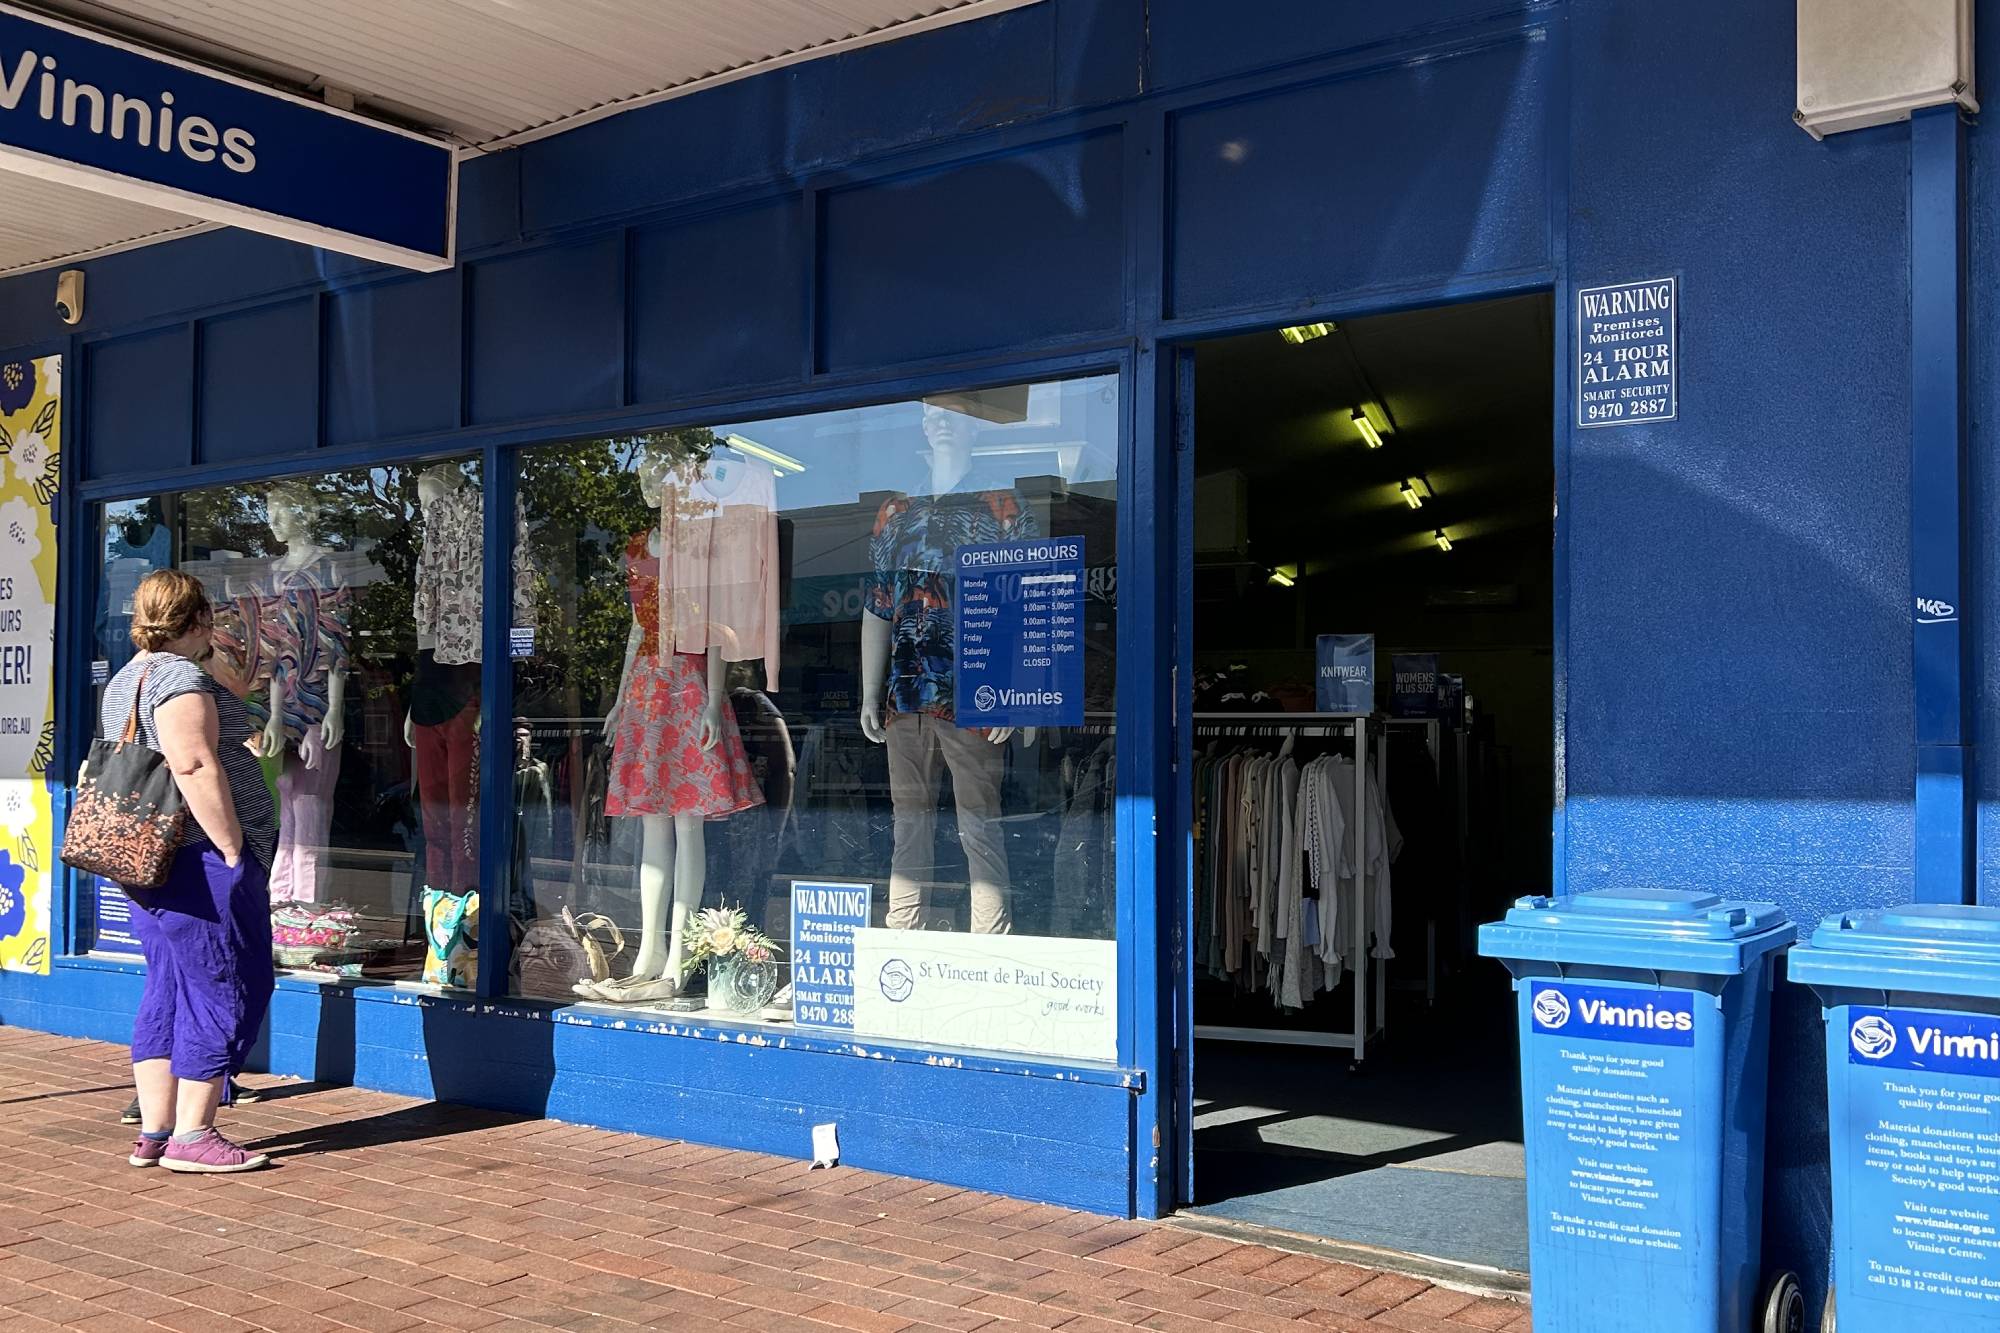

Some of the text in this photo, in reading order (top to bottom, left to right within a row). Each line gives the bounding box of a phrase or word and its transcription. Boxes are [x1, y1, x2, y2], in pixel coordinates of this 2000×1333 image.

[0, 50, 257, 173] Vinnies
[1584, 285, 1670, 318] WARNING
[1593, 318, 1660, 332] Premises
[1589, 326, 1664, 344] Monitored
[1584, 344, 1670, 365] 24 HOUR
[1584, 360, 1670, 384] ALARM
[1584, 384, 1670, 402] SMART SECURITY
[1588, 398, 1666, 418] 9470 2887
[962, 545, 1078, 566] OPENING HOURS
[964, 580, 988, 588] Monday
[964, 593, 988, 602] Tuesday
[964, 607, 998, 616] Wednesday
[964, 620, 992, 630] Thursday
[964, 634, 982, 642] Friday
[964, 647, 990, 656] Saturday
[0, 645, 32, 684] ER!
[964, 658, 1050, 670] Sunday CLOSED
[1321, 666, 1366, 678] KNITWEAR
[1396, 672, 1434, 684] WOMENS
[999, 688, 1063, 706] Vinnies
[1396, 683, 1434, 694] PLUS SIZE
[796, 890, 865, 918] WARNING
[803, 920, 856, 933] Premises
[795, 950, 855, 967] 24 HOU
[919, 962, 1104, 994] St Vincent de Paul Society
[796, 990, 822, 1002] SMART
[800, 1007, 828, 1022] 9470
[1041, 999, 1105, 1016] good works
[1578, 998, 1692, 1031] Vinnies
[1560, 1050, 1664, 1068] Thank you for your good
[1572, 1064, 1600, 1075] quality
[1557, 1084, 1657, 1103] Material donations such
[1883, 1082, 1980, 1100] Thank you for your
[1636, 1106, 1682, 1116] household
[1899, 1098, 1991, 1114] quality donations.
[1574, 1110, 1600, 1120] books
[1602, 1114, 1617, 1122] and
[1620, 1117, 1638, 1126] toys
[1655, 1120, 1680, 1129] given
[1546, 1120, 1680, 1141] away sold help support the
[1879, 1120, 1920, 1133] Material
[1923, 1126, 1974, 1139] donations
[1606, 1138, 1628, 1148] good
[1865, 1132, 1974, 1154] clothing, manchester,
[1868, 1144, 1996, 1168] items, books and toys are
[1578, 1157, 1648, 1174] Visit our website
[1865, 1159, 1964, 1180] away or sold to help
[1580, 1182, 1604, 1192] locate
[1606, 1187, 1626, 1195] your
[1628, 1190, 1658, 1198] nearest
[1892, 1174, 1936, 1188] Society's
[1938, 1182, 1964, 1192] good
[1582, 1192, 1612, 1204] Vinnies
[1904, 1200, 1990, 1220] Visit our website
[1550, 1211, 1681, 1238] To make credit card donation
[1895, 1215, 1996, 1235] www.vinnies.org.au
[1567, 1226, 1575, 1234] 13
[1588, 1230, 1596, 1238] 12
[1598, 1232, 1608, 1240] or
[1609, 1233, 1627, 1242] visit
[1628, 1237, 1644, 1245] our
[1905, 1228, 1936, 1240] locate
[1938, 1234, 1960, 1242] your
[1906, 1240, 1986, 1260] Vinnies Centre.
[1868, 1260, 1978, 1286] To make credit card
[1868, 1274, 1982, 1300] call 13 18 12 or visit our
